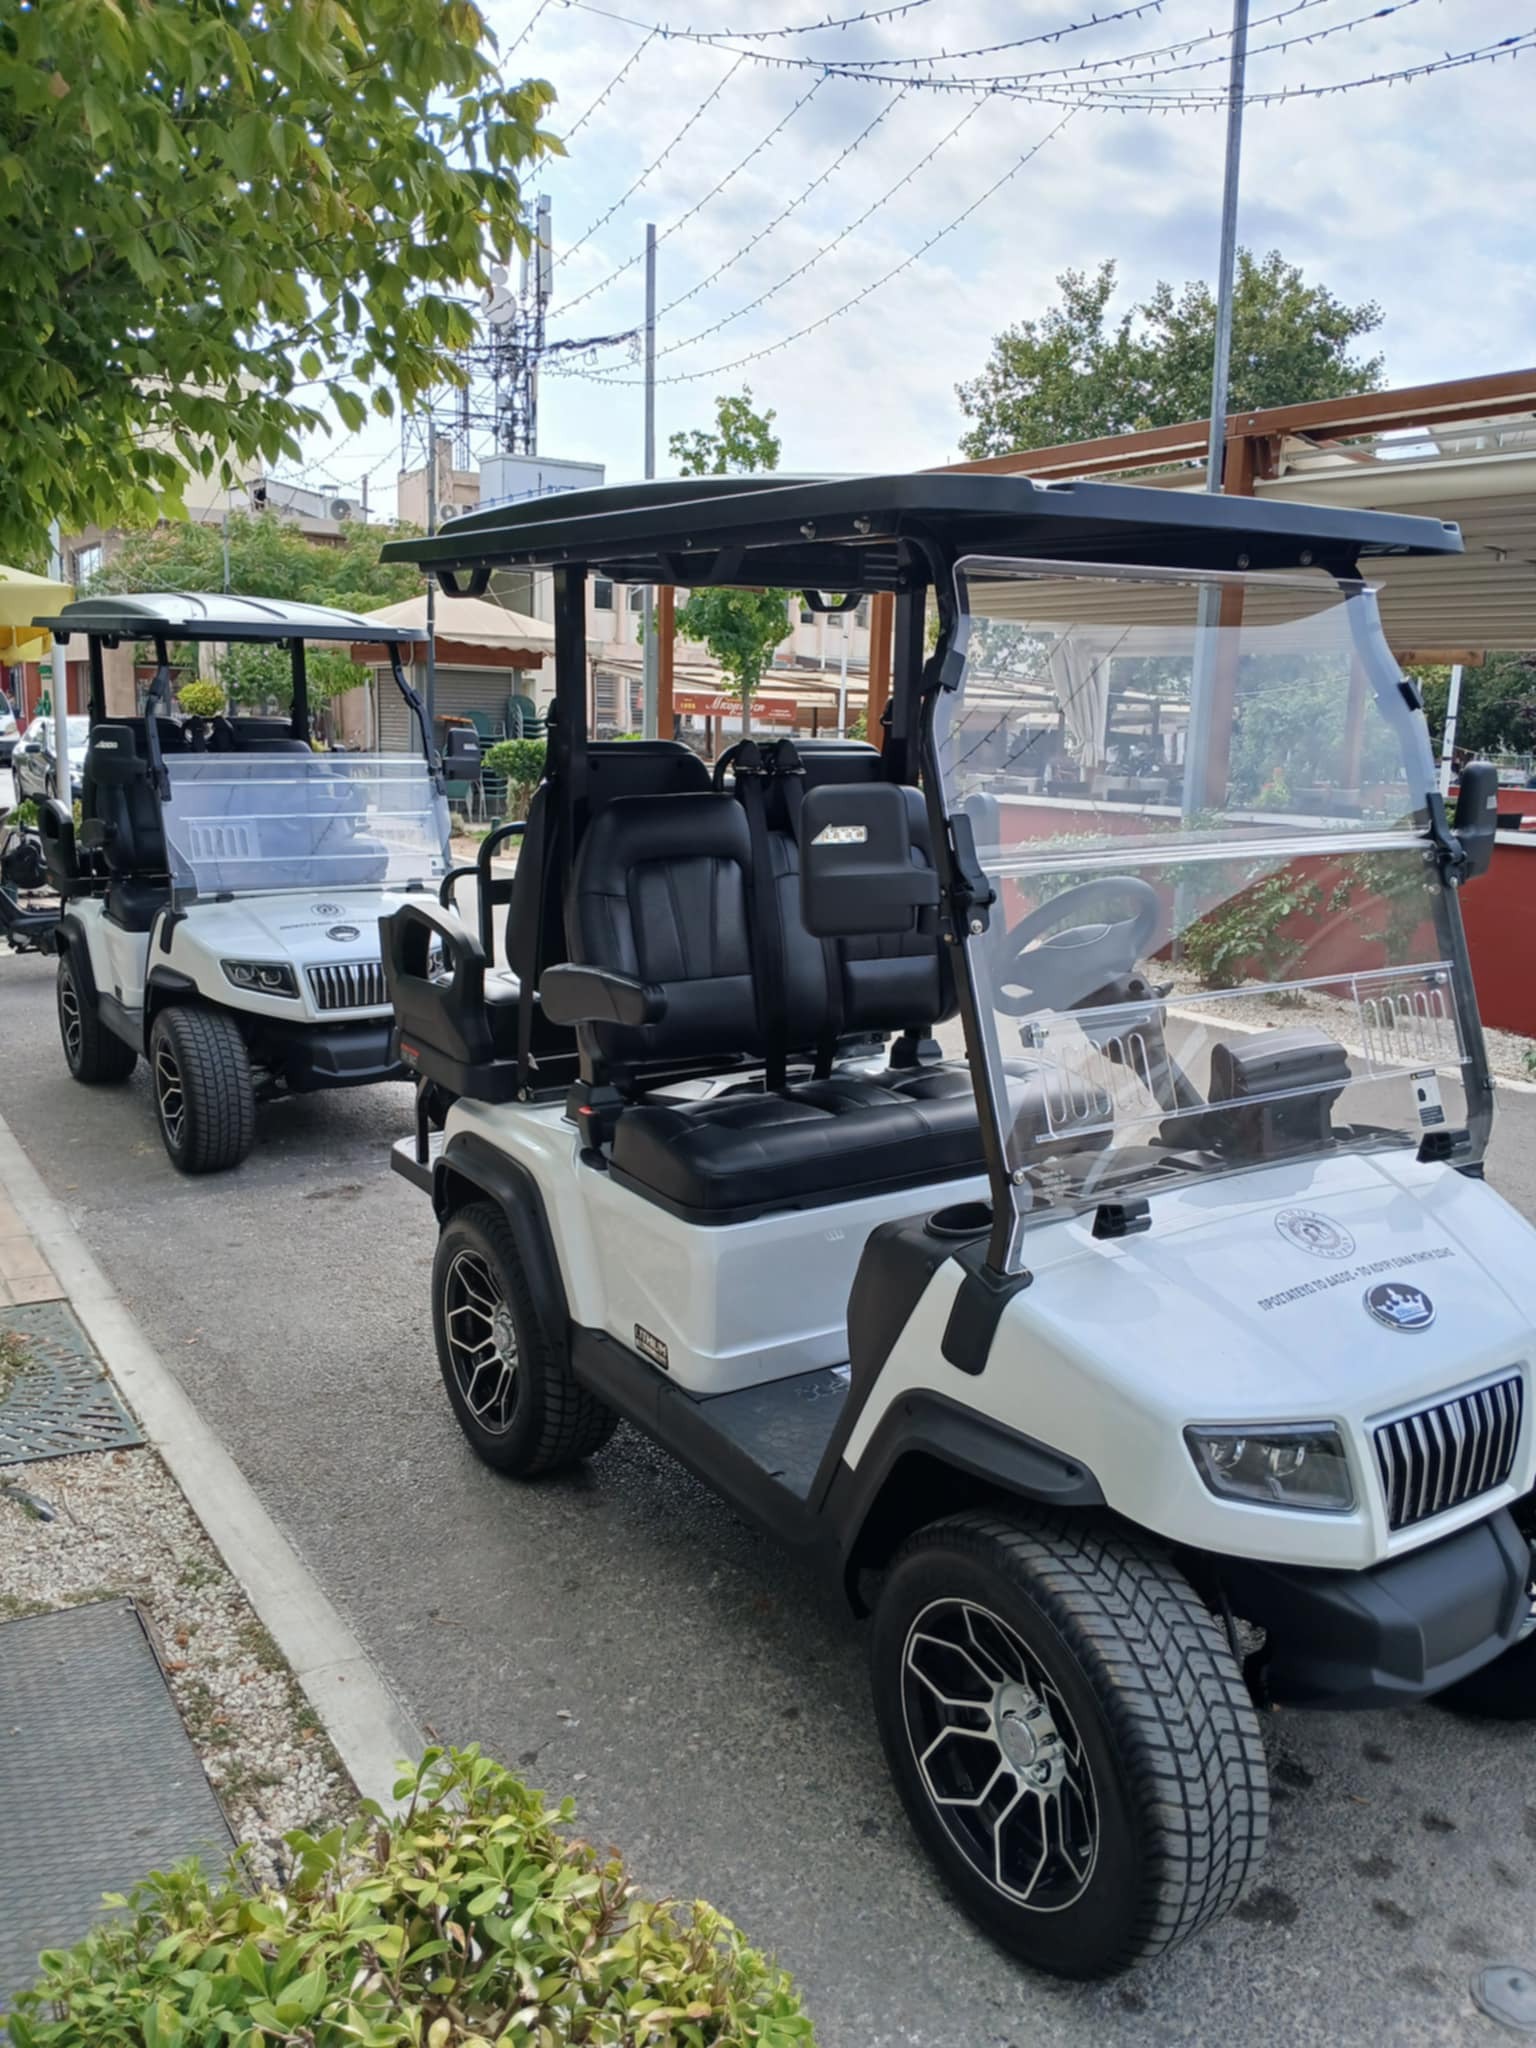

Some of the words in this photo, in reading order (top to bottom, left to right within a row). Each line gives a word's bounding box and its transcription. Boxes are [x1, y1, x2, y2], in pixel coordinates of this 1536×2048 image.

[1257, 1283, 1317, 1311] ΠΡΟΣΤΑΤΕΥΩ
[1311, 1279, 1329, 1291] ΤΟ
[1324, 1270, 1356, 1287] ΔΑΣΟΣ
